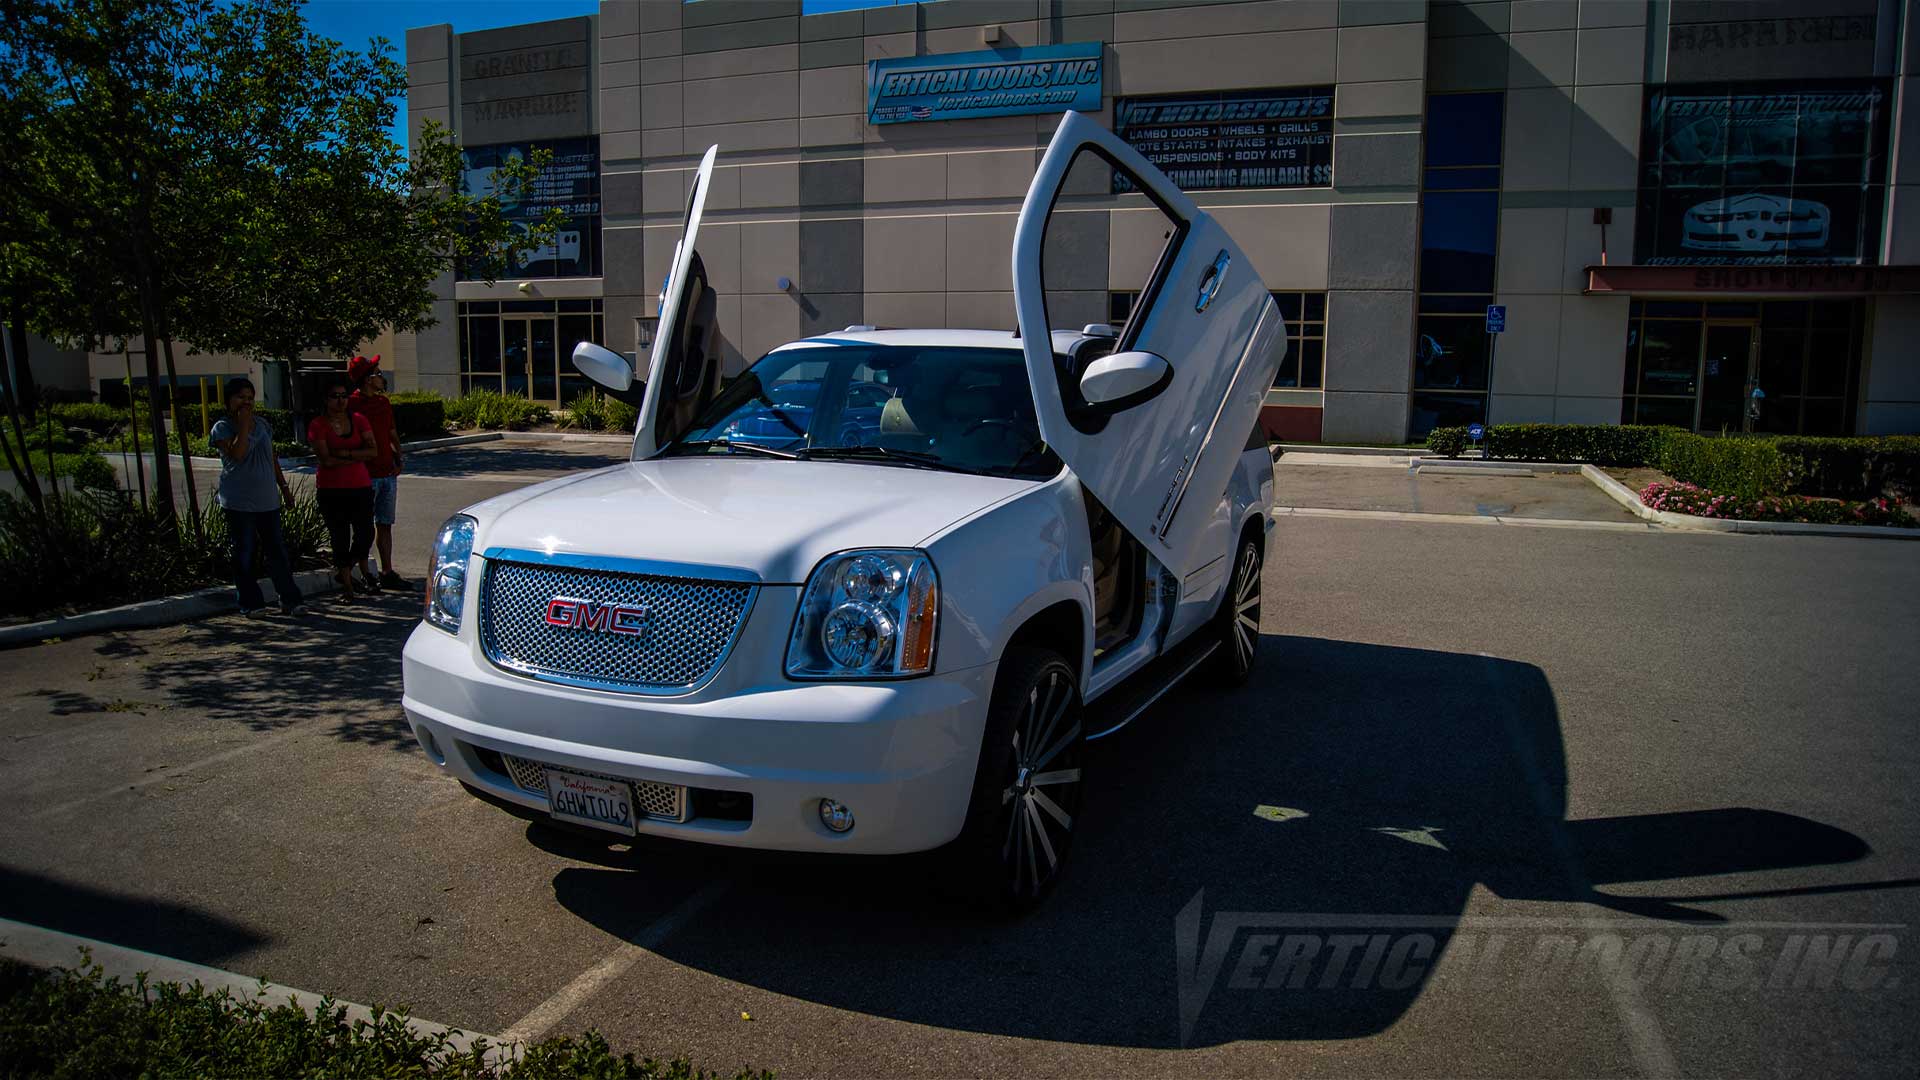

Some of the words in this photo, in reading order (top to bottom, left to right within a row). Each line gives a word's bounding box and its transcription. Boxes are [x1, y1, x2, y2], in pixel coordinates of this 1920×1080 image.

[936, 90, 1078, 111] VerticalDoors.com
[1157, 98, 1330, 122] MOTORSPORTS
[1129, 128, 1168, 140] LAMBO
[1171, 127, 1209, 138] DOORS
[1218, 124, 1265, 136] WHEELS
[1279, 121, 1319, 133] GRILLS
[1162, 140, 1208, 151] STARTS
[1217, 137, 1266, 149] INTAKES
[1276, 134, 1331, 146] EXHAUST
[1148, 152, 1224, 164] SUSPENSIONS
[1234, 150, 1267, 161] BODY
[1270, 148, 1297, 160] KITS
[1239, 164, 1311, 187] AVAILABLE
[545, 596, 649, 637] GMC
[560, 776, 610, 794] California
[557, 790, 628, 824] 6HWT049
